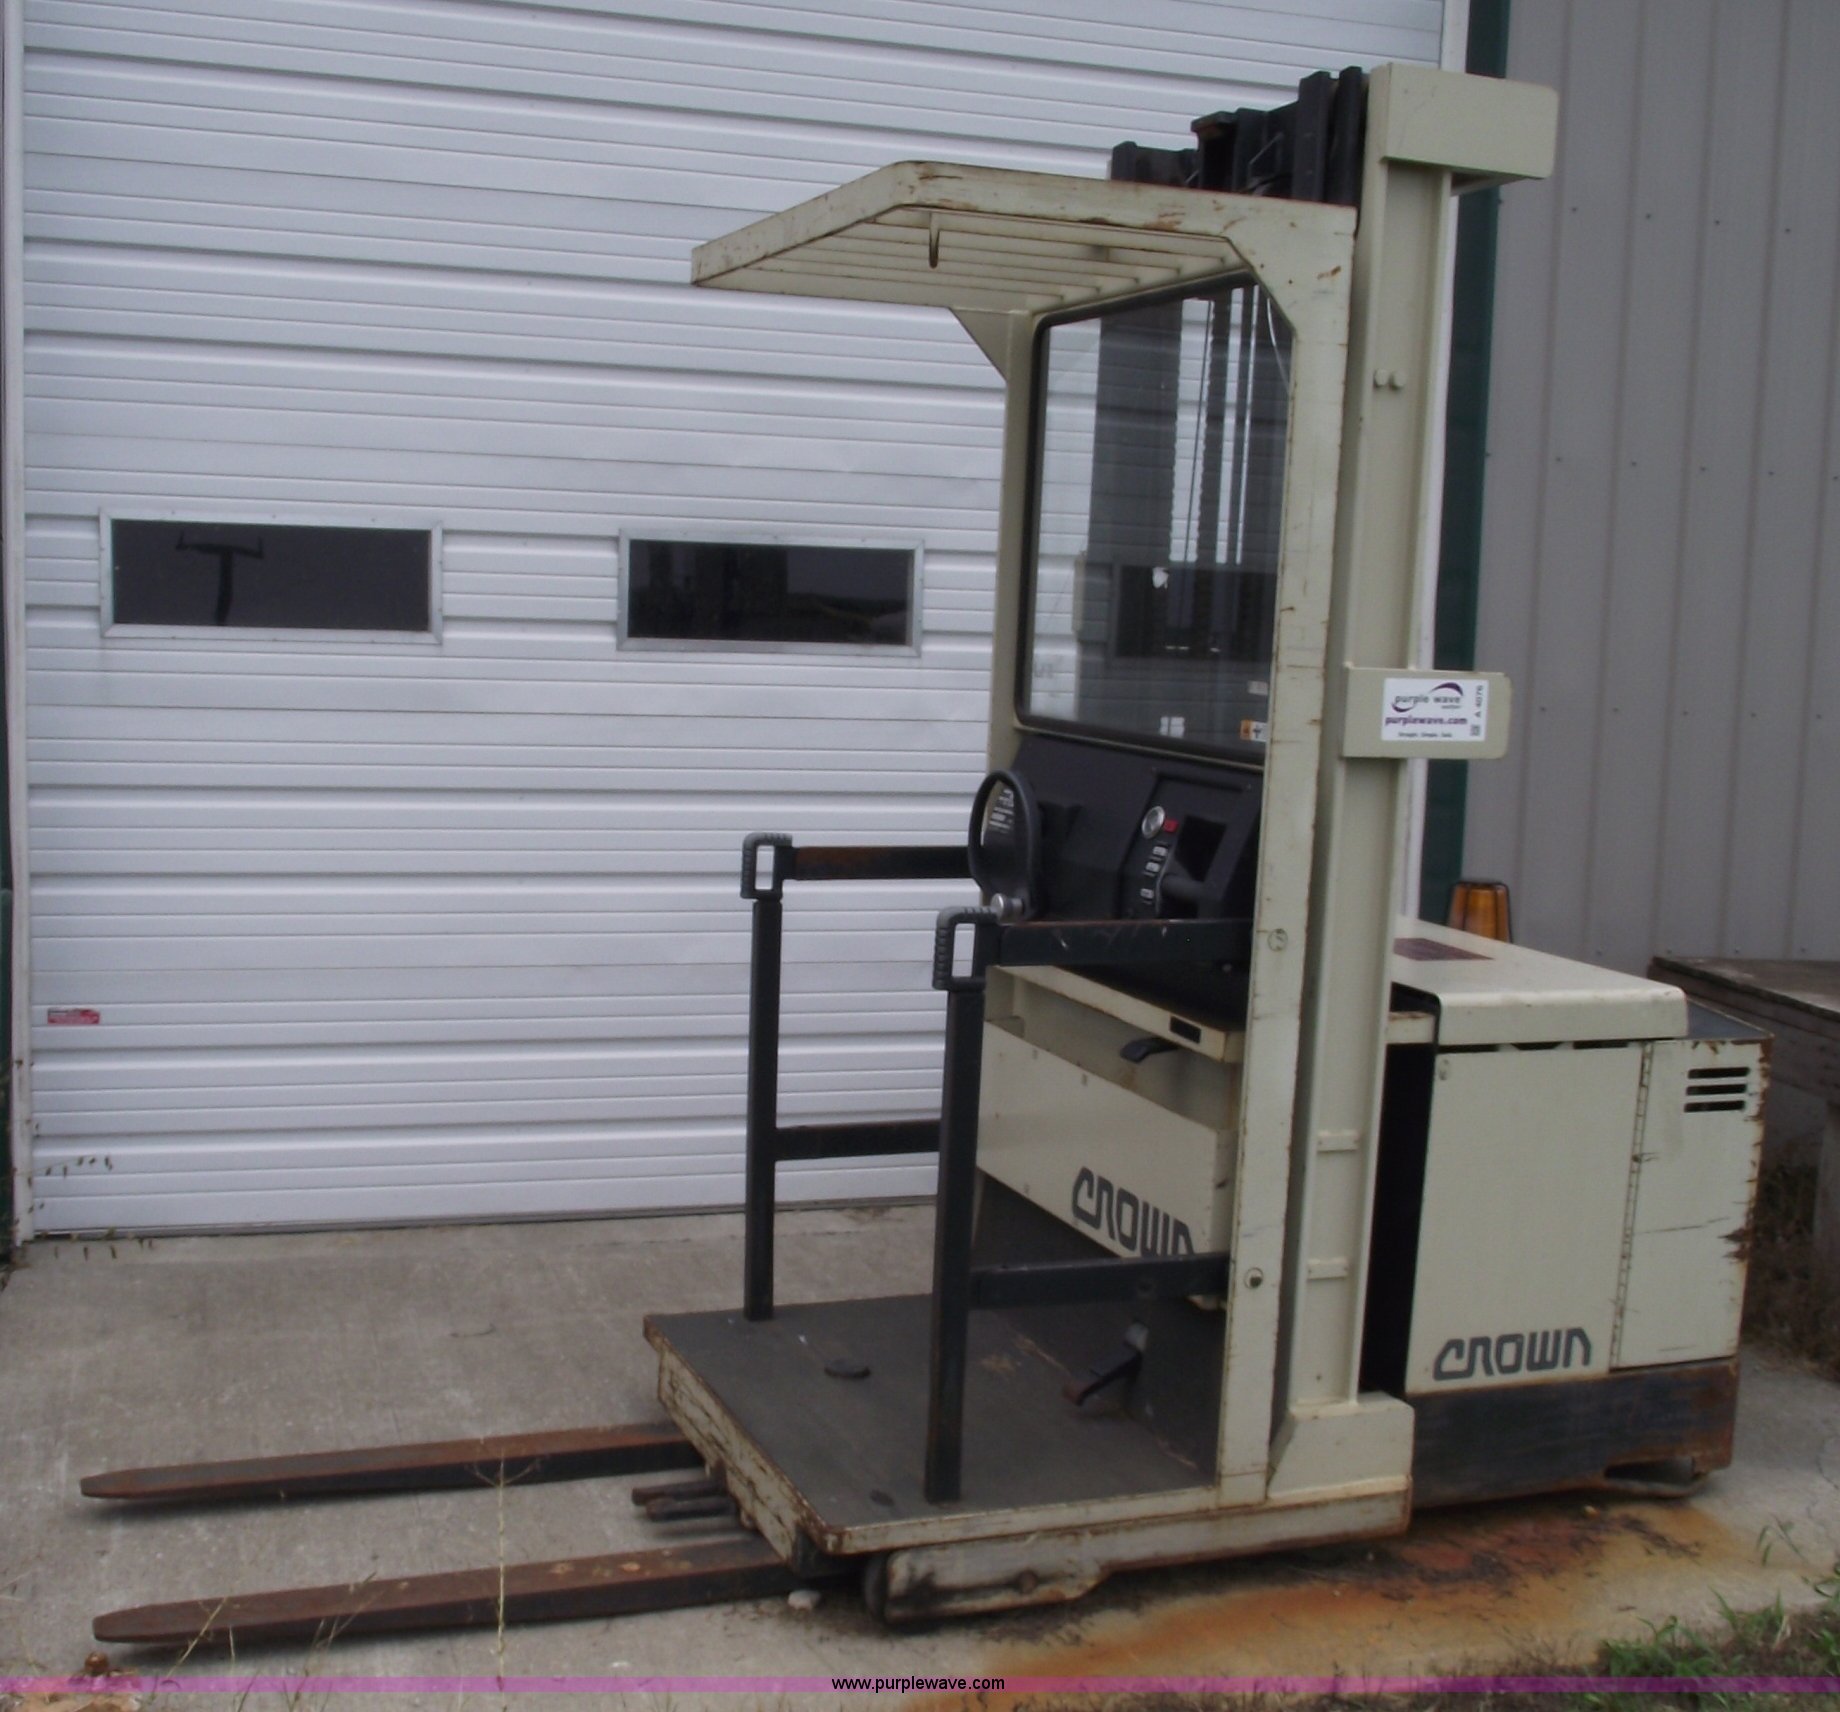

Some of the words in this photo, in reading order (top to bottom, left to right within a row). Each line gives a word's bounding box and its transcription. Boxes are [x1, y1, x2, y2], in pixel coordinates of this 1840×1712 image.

[1395, 694, 1429, 705] purple
[1433, 696, 1461, 704] wave
[1385, 715, 1468, 726] purplewave.com
[1072, 1166, 1195, 1257] CROWN
[1433, 1327, 1592, 1381] CROWN
